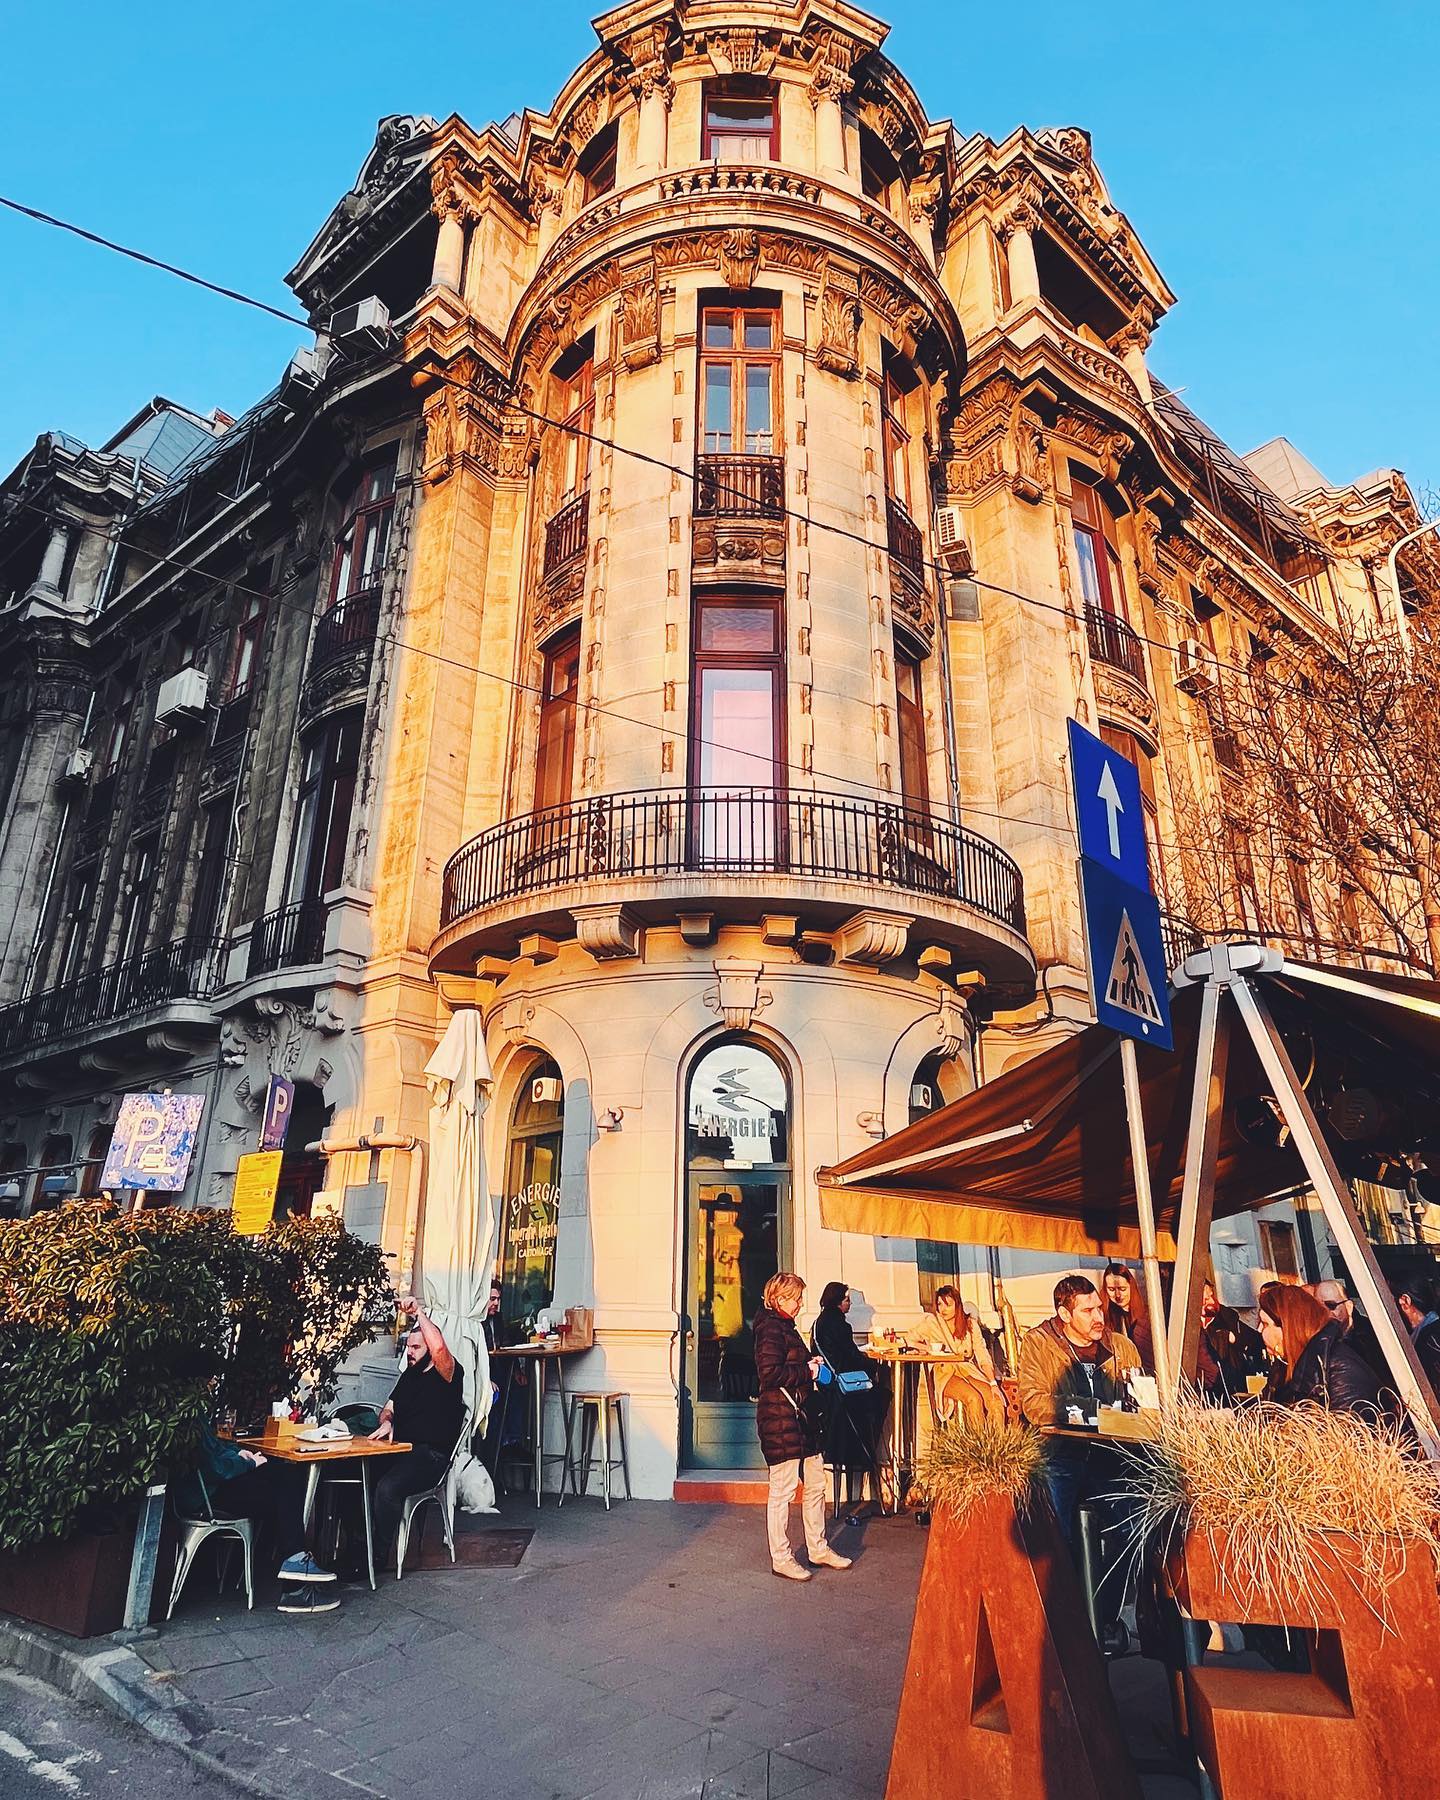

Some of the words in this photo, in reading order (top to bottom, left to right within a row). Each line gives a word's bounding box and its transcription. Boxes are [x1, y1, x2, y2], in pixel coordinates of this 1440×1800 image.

[272, 1086, 288, 1127] P
[123, 1111, 166, 1168] P
[697, 1117, 778, 1138] ENERGIEA
